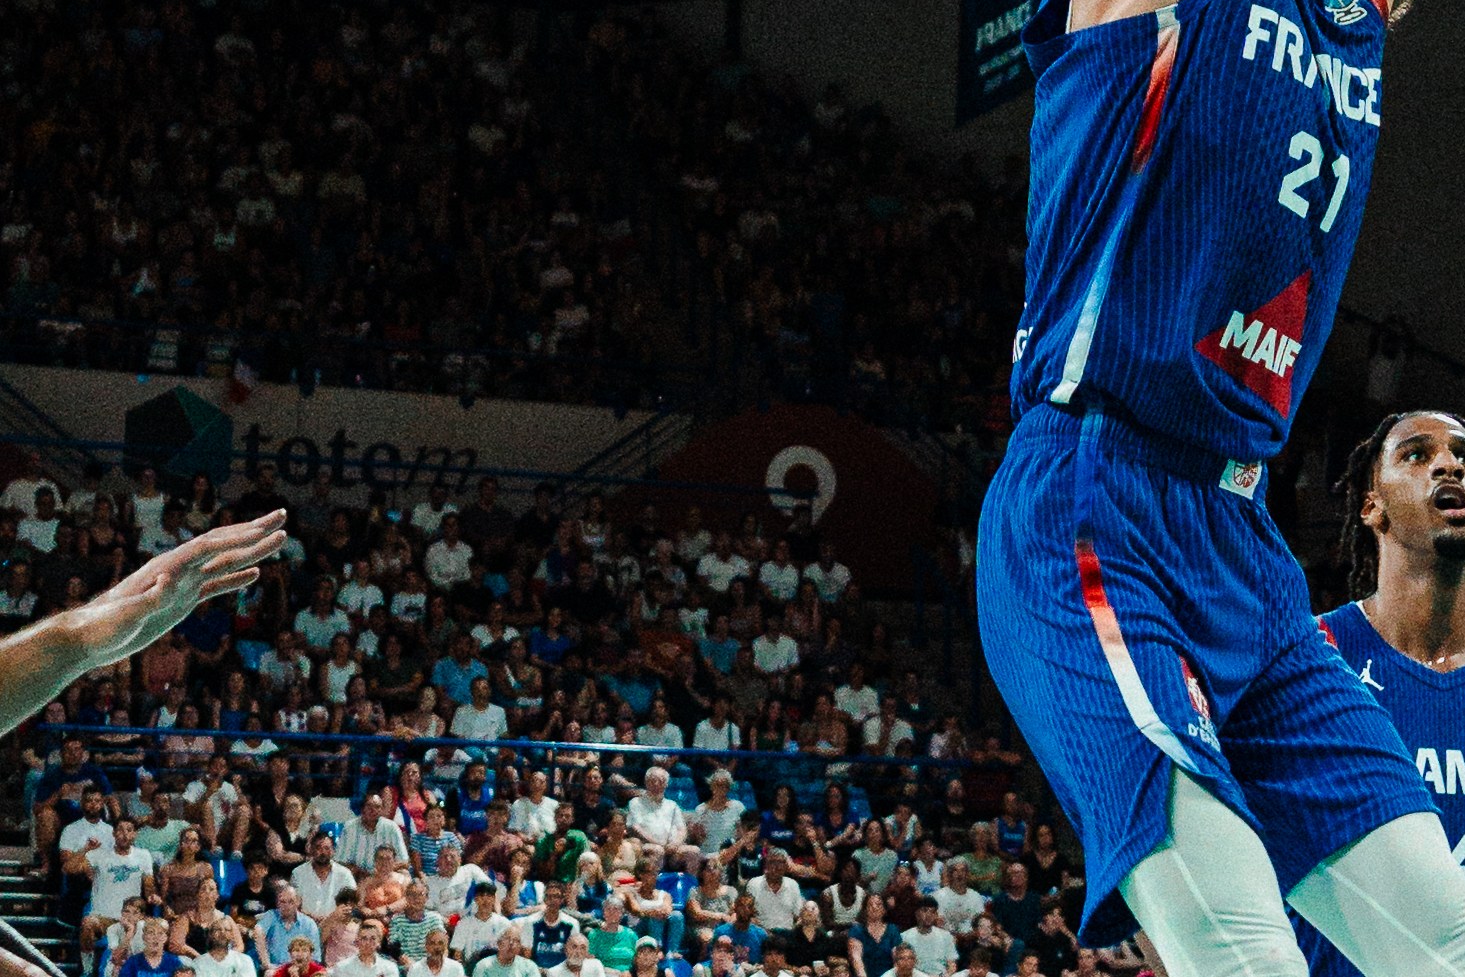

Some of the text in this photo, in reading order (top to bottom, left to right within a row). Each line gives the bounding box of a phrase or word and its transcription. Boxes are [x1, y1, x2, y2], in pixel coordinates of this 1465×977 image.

[1278, 130, 1350, 233] 21
[1219, 310, 1302, 378] MAIF
[241, 423, 479, 495] totem
